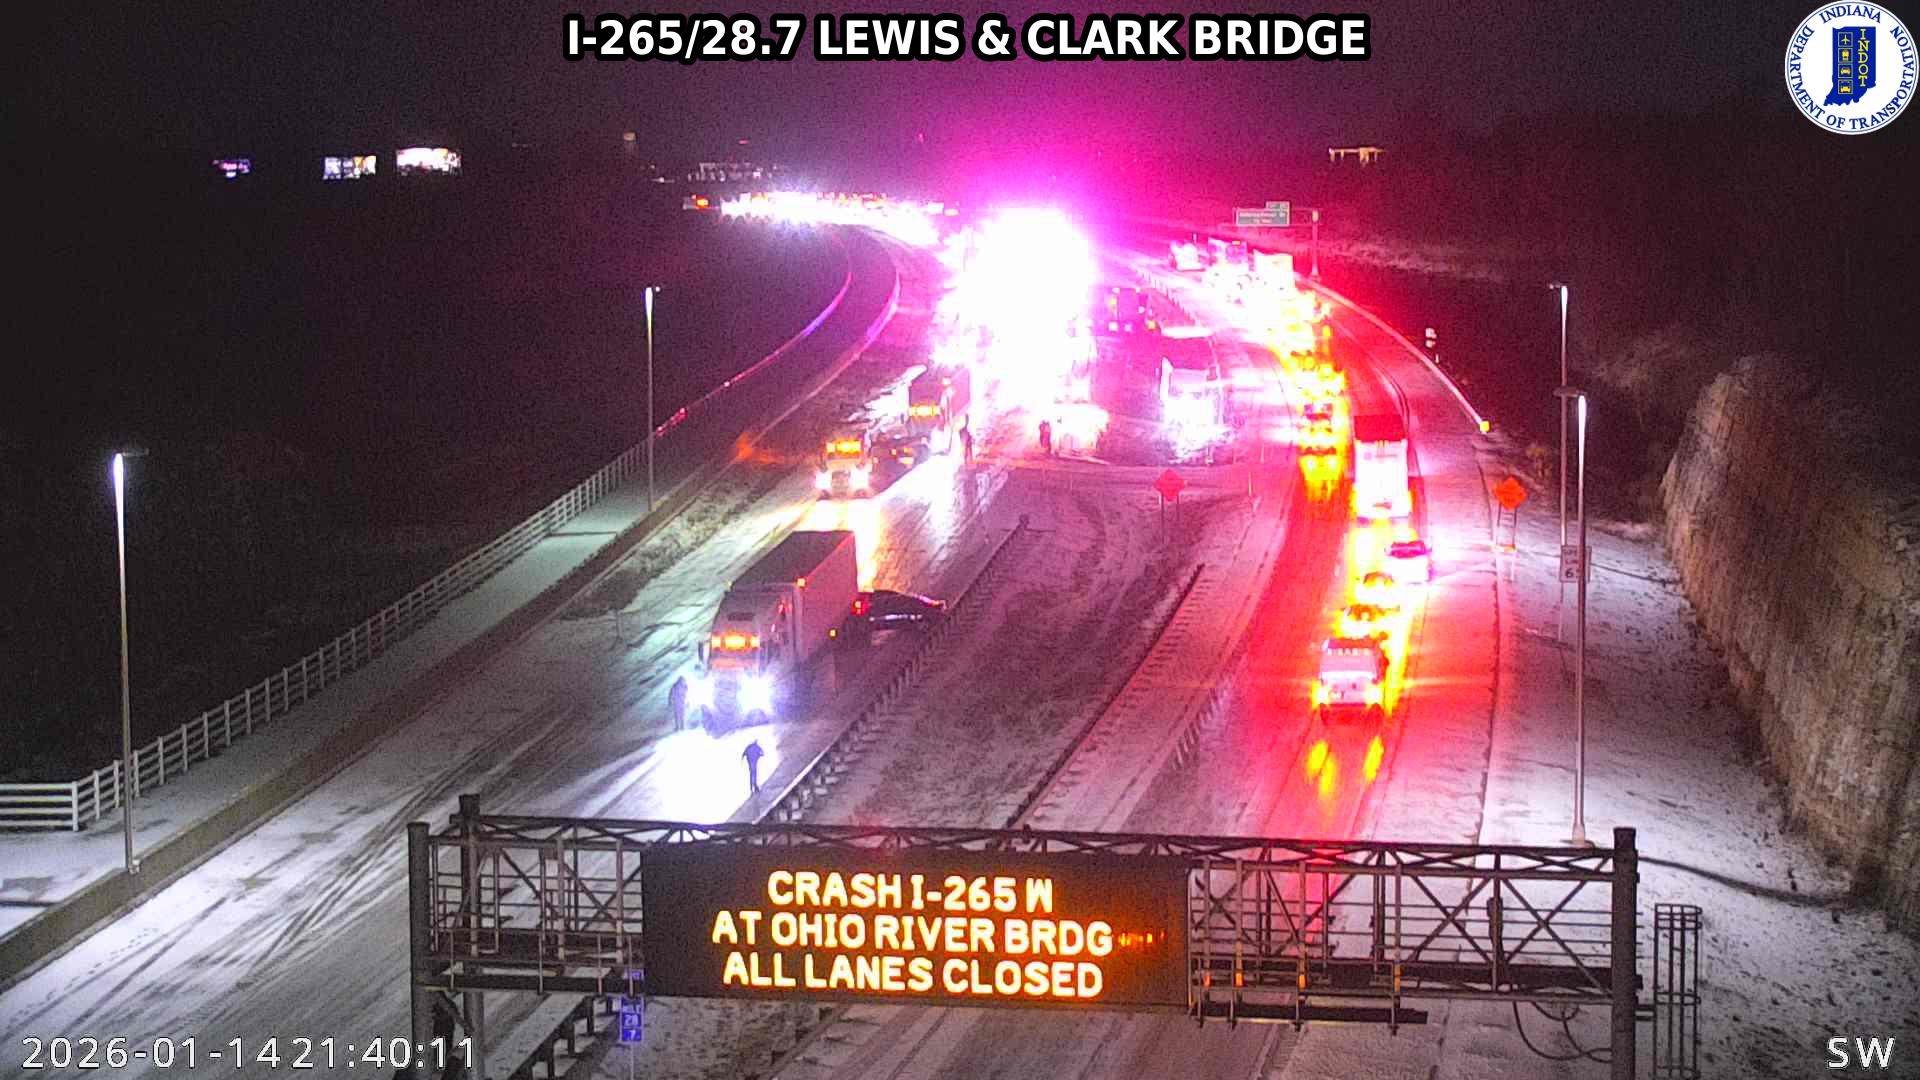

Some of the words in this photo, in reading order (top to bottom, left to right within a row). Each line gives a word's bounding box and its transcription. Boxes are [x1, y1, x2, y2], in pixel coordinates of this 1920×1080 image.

[767, 871, 901, 909] CRASH
[911, 874, 1017, 912] I-265
[1025, 878, 1053, 913] W
[711, 911, 762, 945] AT
[771, 913, 865, 949] OHIO
[874, 915, 996, 954] RIVER
[1004, 920, 1113, 956] BRDG
[722, 952, 797, 987] ALL
[804, 953, 933, 993] LANES
[942, 959, 1103, 998] CLOSED
